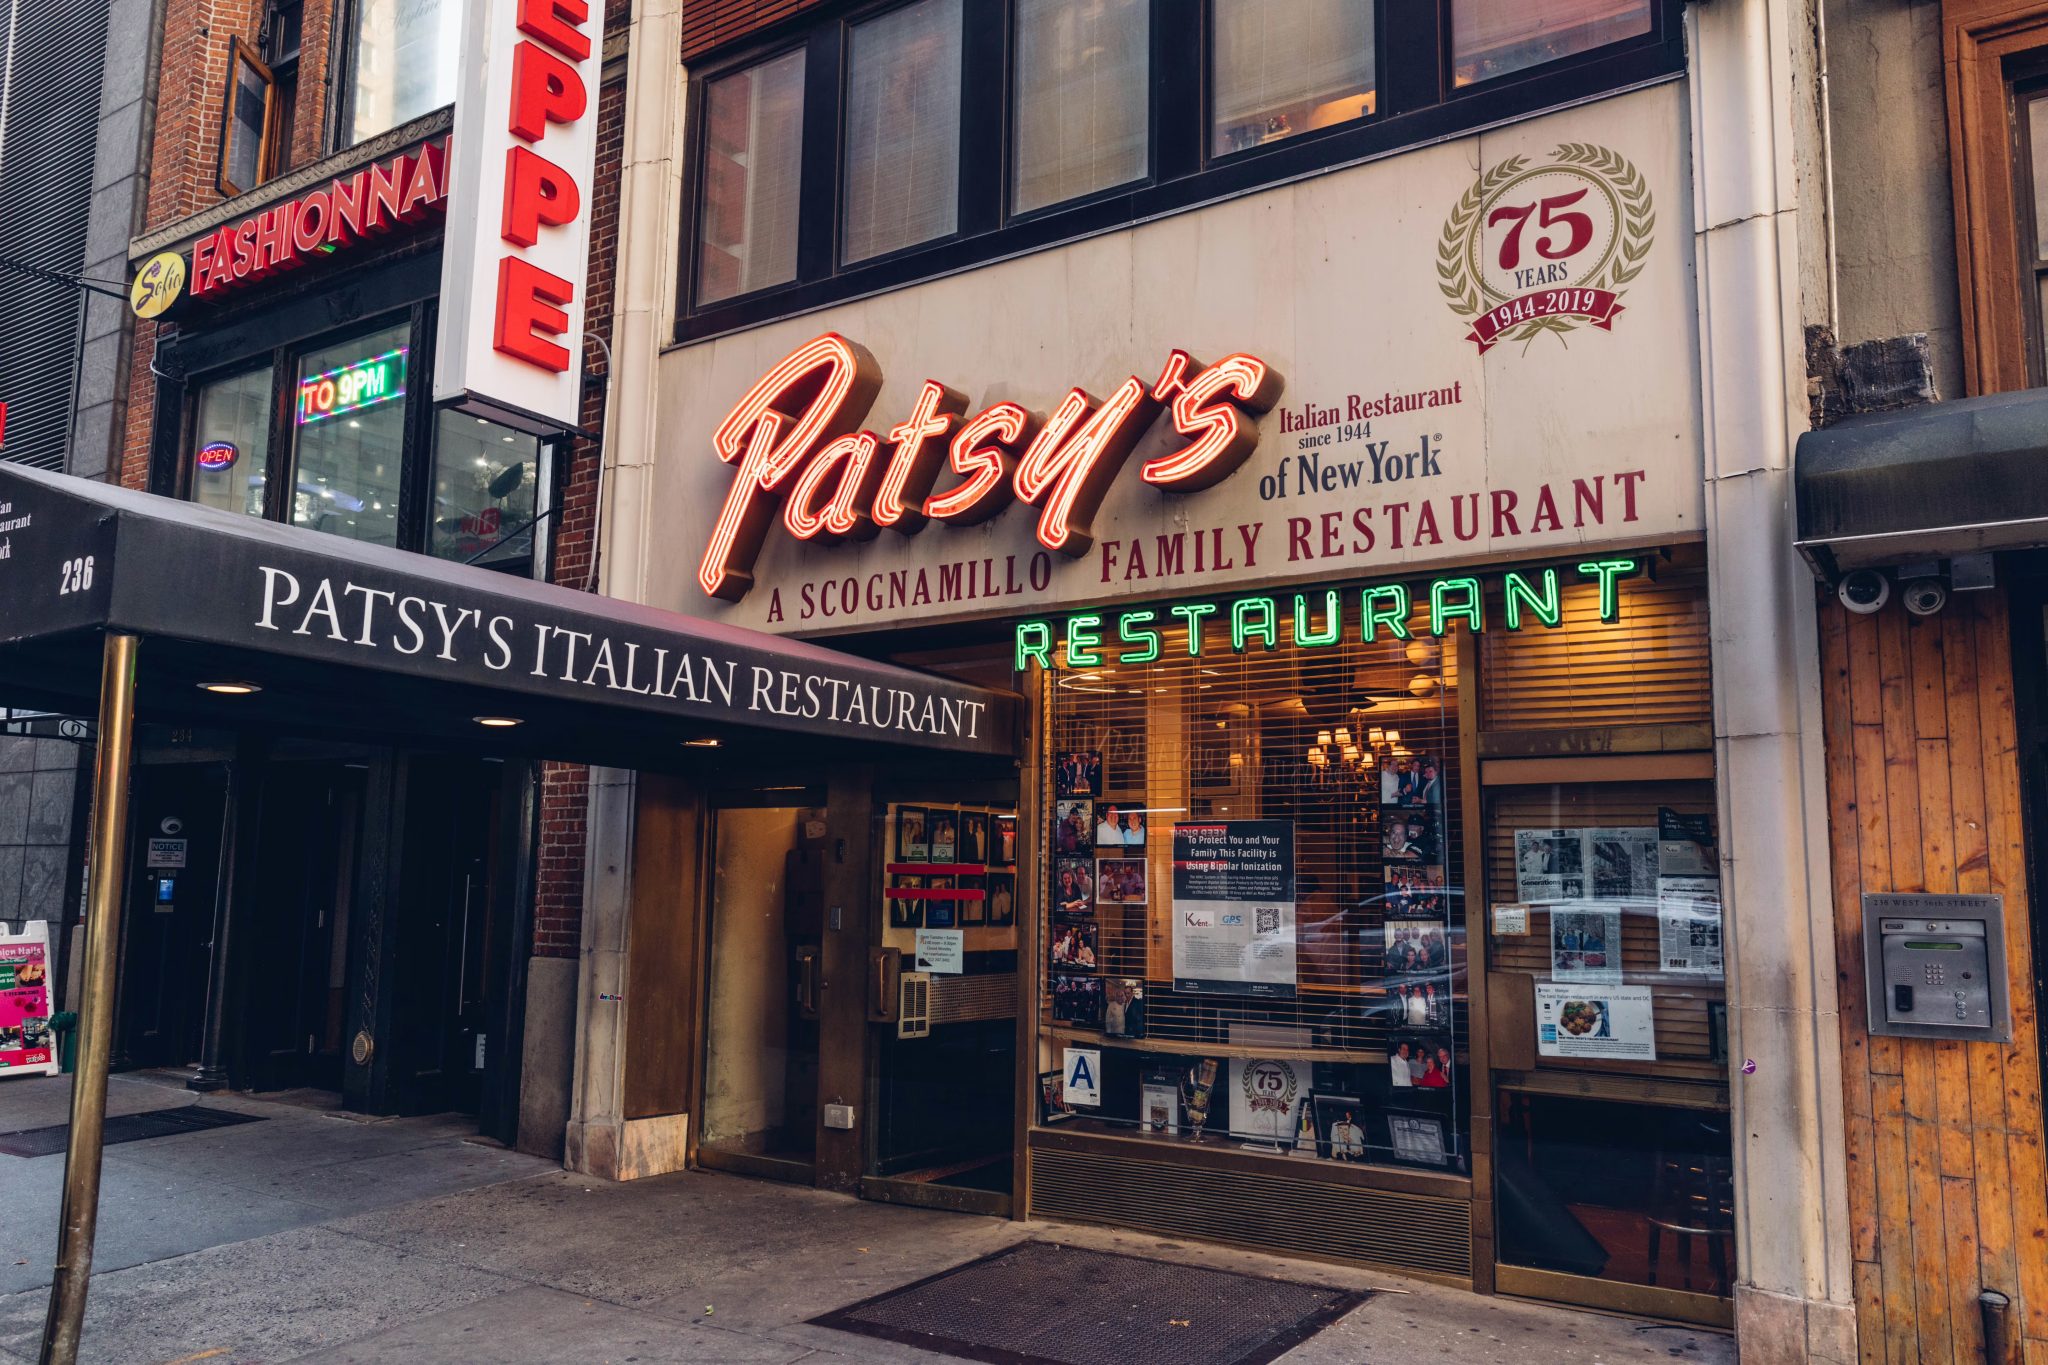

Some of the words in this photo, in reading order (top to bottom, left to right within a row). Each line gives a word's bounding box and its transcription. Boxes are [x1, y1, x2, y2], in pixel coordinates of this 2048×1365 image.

[1488, 188, 1593, 270] 75
[1514, 261, 1568, 289] YEARS
[1488, 290, 1595, 332] 1944-2019
[304, 380, 334, 414] TO
[338, 364, 386, 405] 9PM
[1280, 404, 1340, 434] Italian
[1347, 380, 1462, 421] Restaurant
[1298, 432, 1331, 449] since
[1336, 421, 1371, 443] 1944
[200, 448, 233, 464] OPEN
[698, 330, 1278, 600] Patsy's
[1259, 457, 1291, 499] of
[767, 590, 784, 623] A
[800, 550, 1052, 619] SCOGNAMILLO
[1101, 521, 1264, 583] FAMILY
[1287, 469, 1646, 562] RESTAURANT
[59, 555, 95, 596] 236
[1015, 558, 1637, 674] RESTAURANT
[254, 566, 514, 670] PATSY'S
[530, 623, 738, 707] ITALIAN
[748, 665, 985, 739] RESTAURANT
[152, 843, 184, 851] NOTICE
[1188, 836, 1197, 844] To
[1199, 835, 1227, 845] Protect
[1229, 836, 1243, 845] You
[1245, 836, 1260, 845] and
[1262, 836, 1280, 845] Your
[1191, 848, 1217, 860] Family
[1219, 848, 1236, 858] This
[1238, 848, 1267, 860] Facility
[1269, 849, 1277, 858] is
[1186, 861, 1208, 873] Using
[1210, 861, 1239, 873] Bipolar
[1241, 862, 1282, 872] Ionization
[1222, 915, 1242, 924] GPS
[1947, 900, 1987, 908] STREET
[18, 946, 41, 955] Nails
[1069, 1055, 1095, 1090] A
[1255, 1069, 1282, 1090] 75
